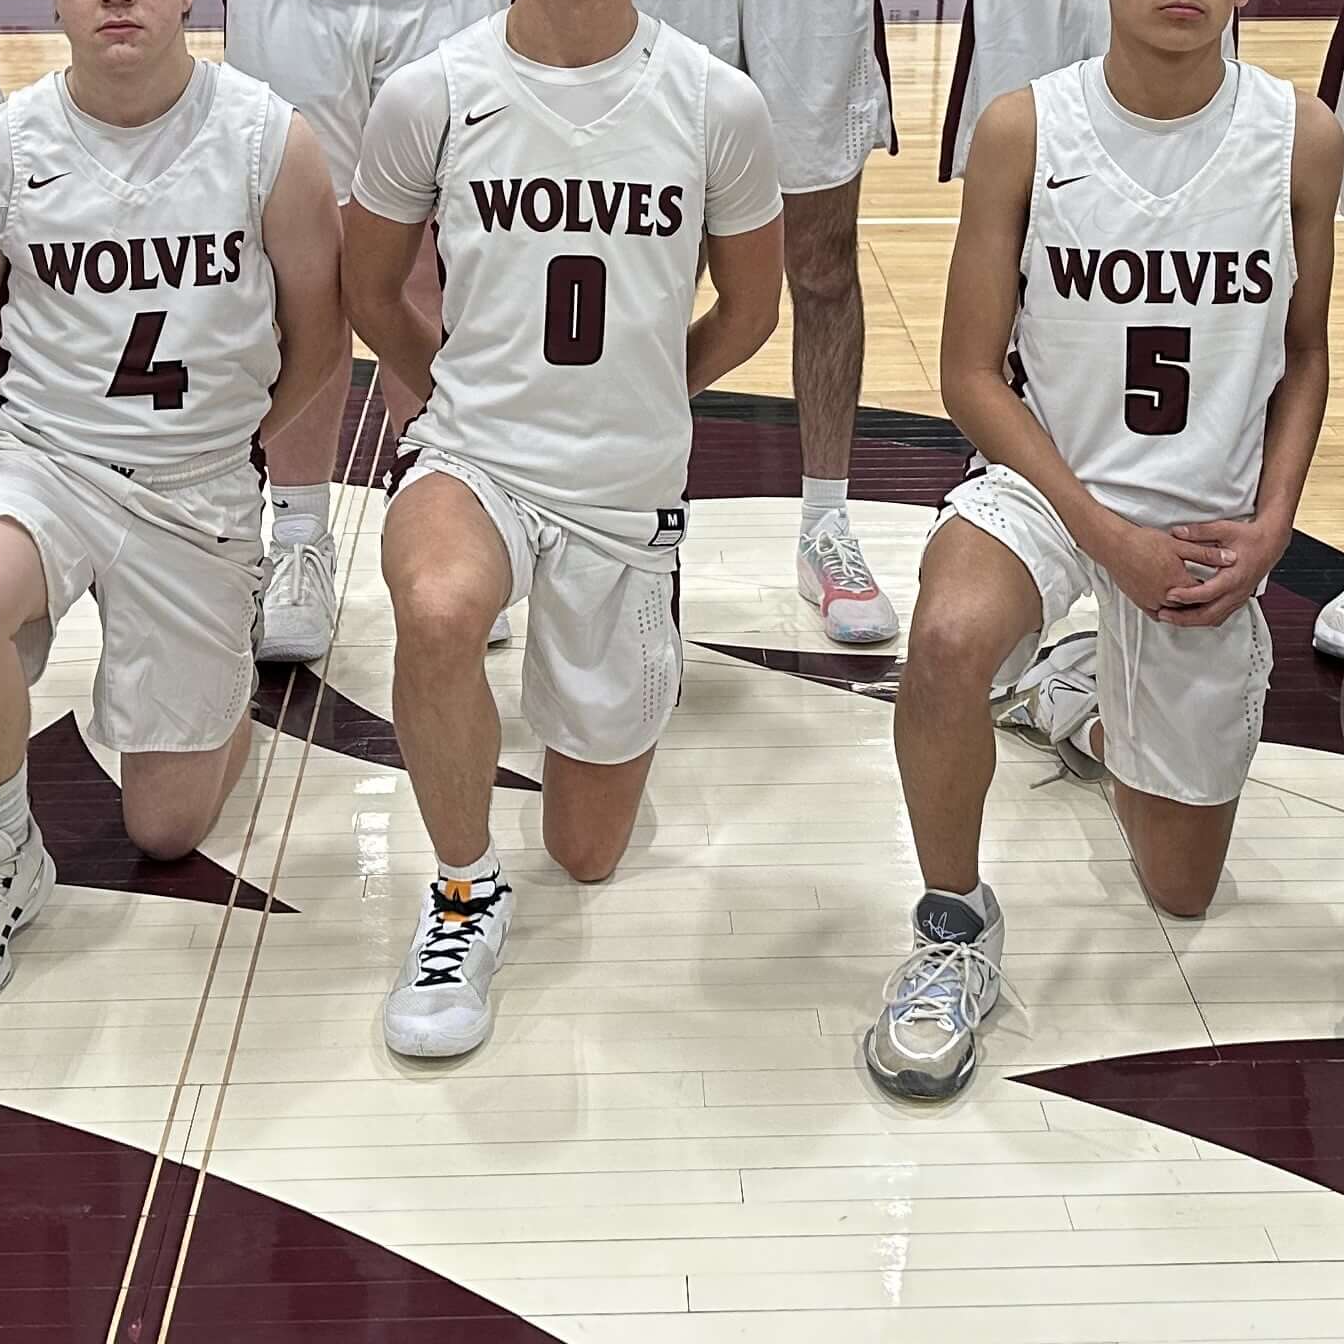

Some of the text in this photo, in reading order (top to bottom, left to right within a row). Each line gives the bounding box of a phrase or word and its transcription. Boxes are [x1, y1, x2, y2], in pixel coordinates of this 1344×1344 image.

[468, 177, 684, 238] WOLVES
[27, 230, 245, 296] WOLVES
[1045, 245, 1274, 307] WOLVES
[543, 254, 607, 367] 0
[104, 310, 189, 411] 4
[1124, 325, 1192, 436] 5
[666, 513, 678, 527] M
